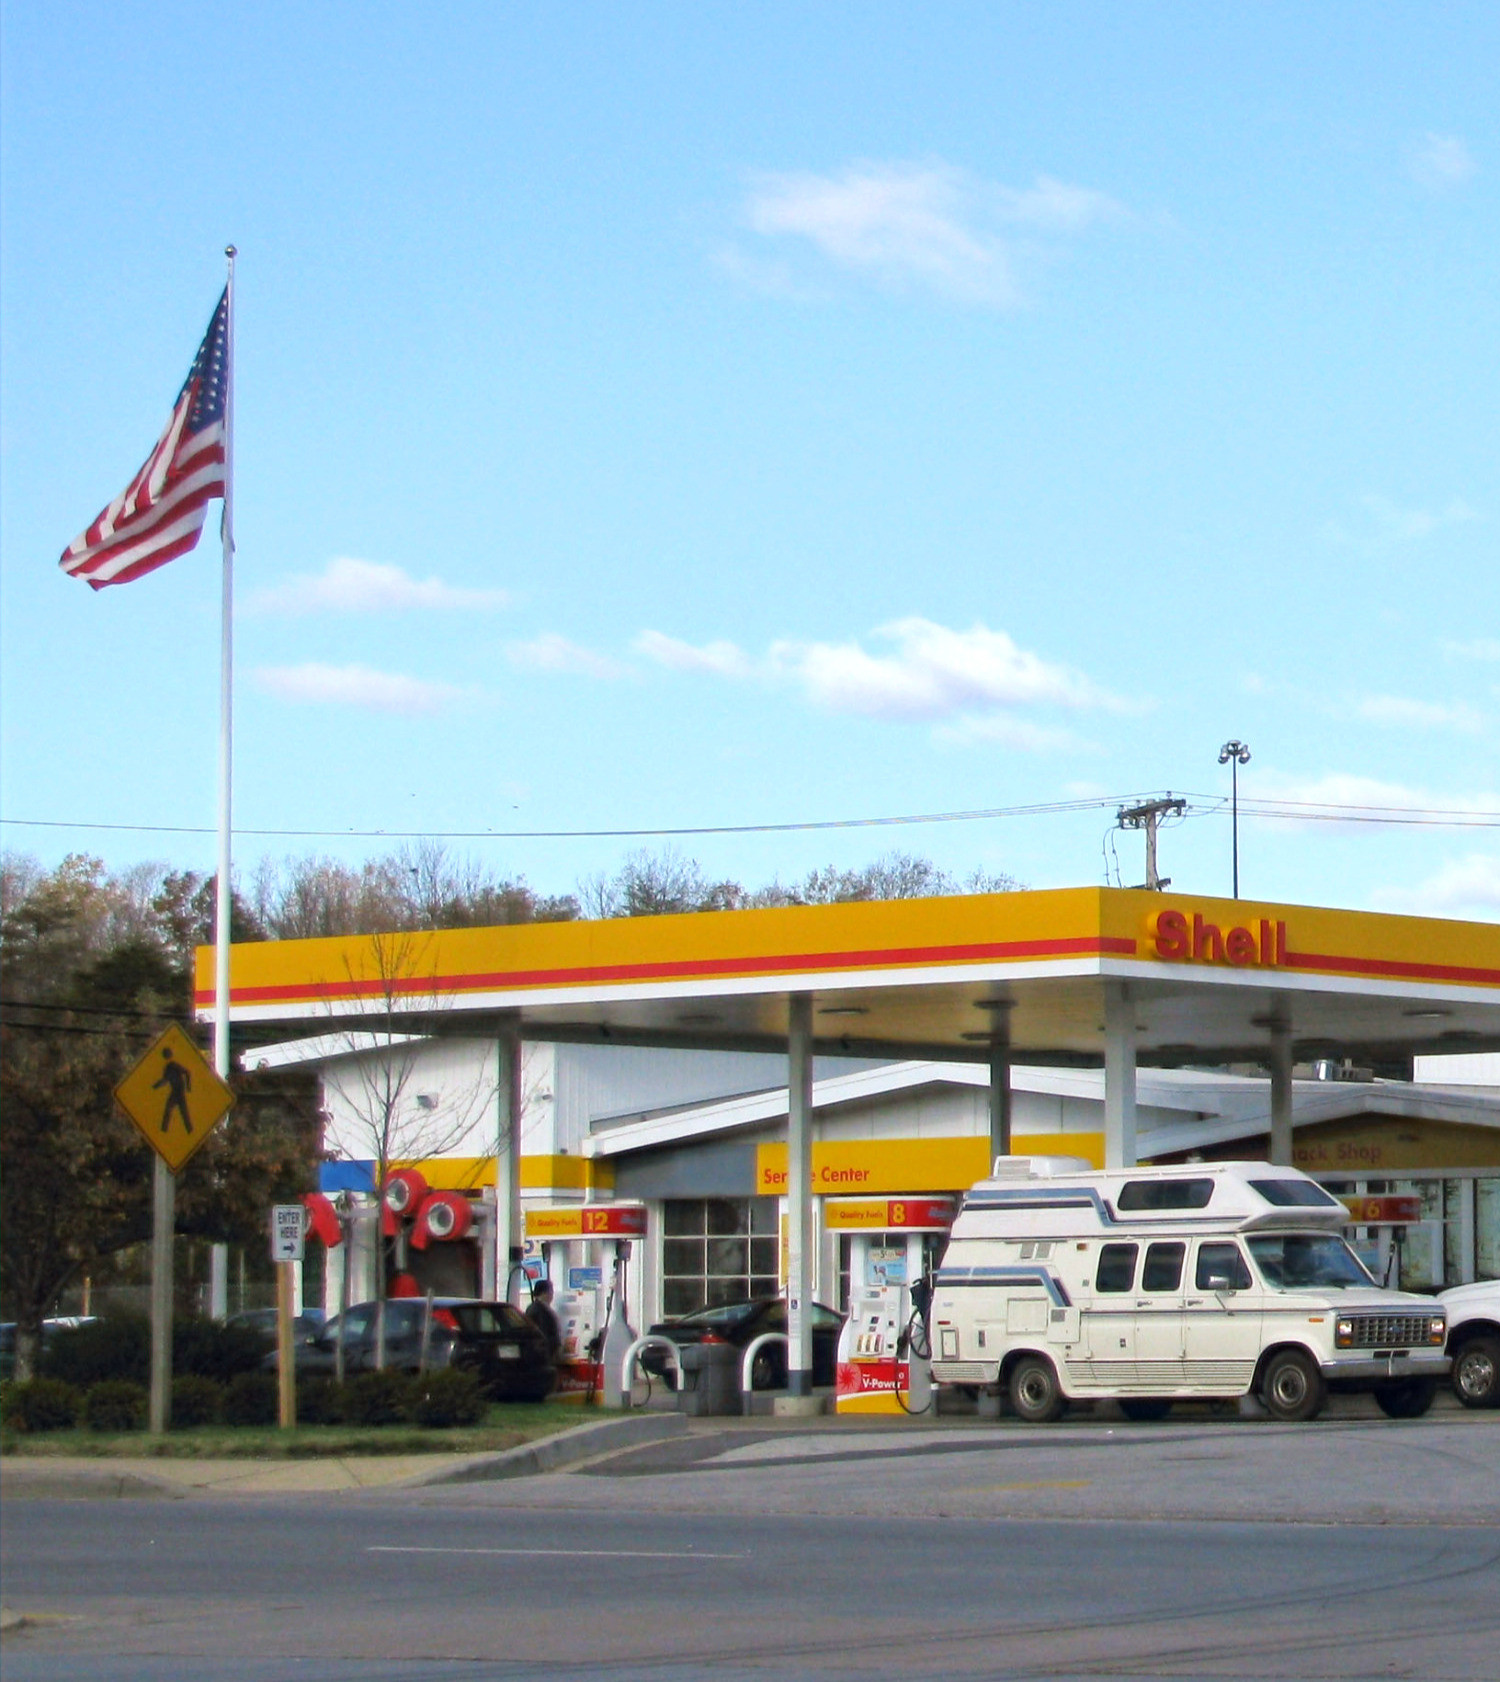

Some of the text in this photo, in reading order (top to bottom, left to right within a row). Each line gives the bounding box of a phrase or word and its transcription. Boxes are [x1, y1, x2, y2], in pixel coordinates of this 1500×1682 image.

[1154, 910, 1286, 966] Shell
[1338, 1142, 1381, 1163] Shop
[821, 1166, 869, 1182] Center
[278, 1211, 301, 1225] ENTER
[840, 1203, 906, 1224] Quality Fuels 8
[1367, 1201, 1380, 1217] 6
[585, 1210, 608, 1231] 12
[281, 1226, 299, 1239] HERE
